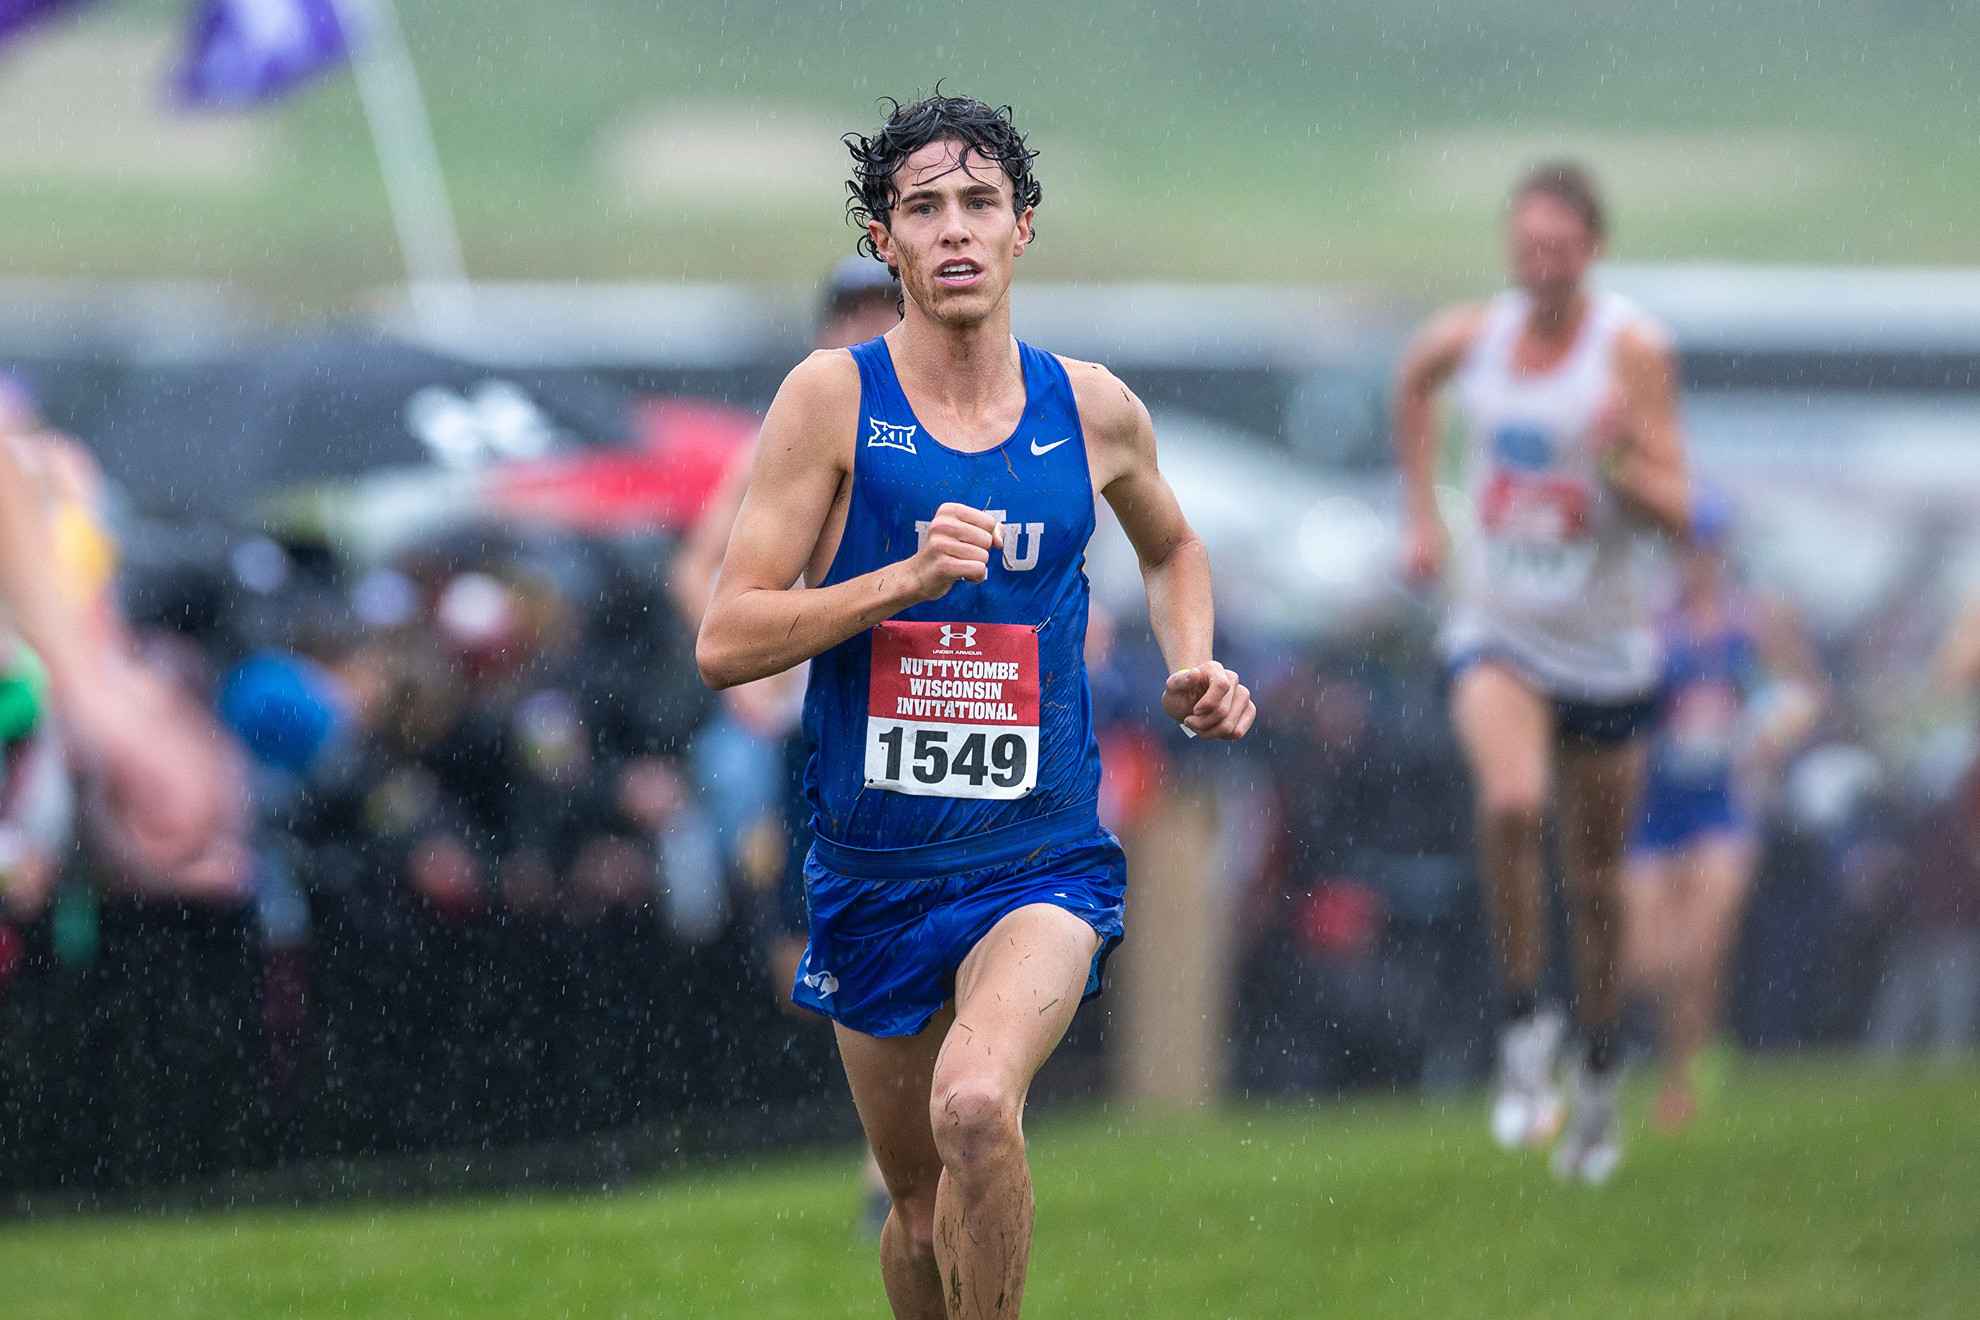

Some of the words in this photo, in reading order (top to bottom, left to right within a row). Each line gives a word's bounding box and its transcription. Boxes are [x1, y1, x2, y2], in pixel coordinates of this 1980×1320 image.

[900, 657, 1019, 680] NUTTYCOMBE
[910, 678, 1003, 700] WISCONSIN
[896, 697, 1018, 721] INVITATIONAL
[878, 726, 1028, 788] 1549
